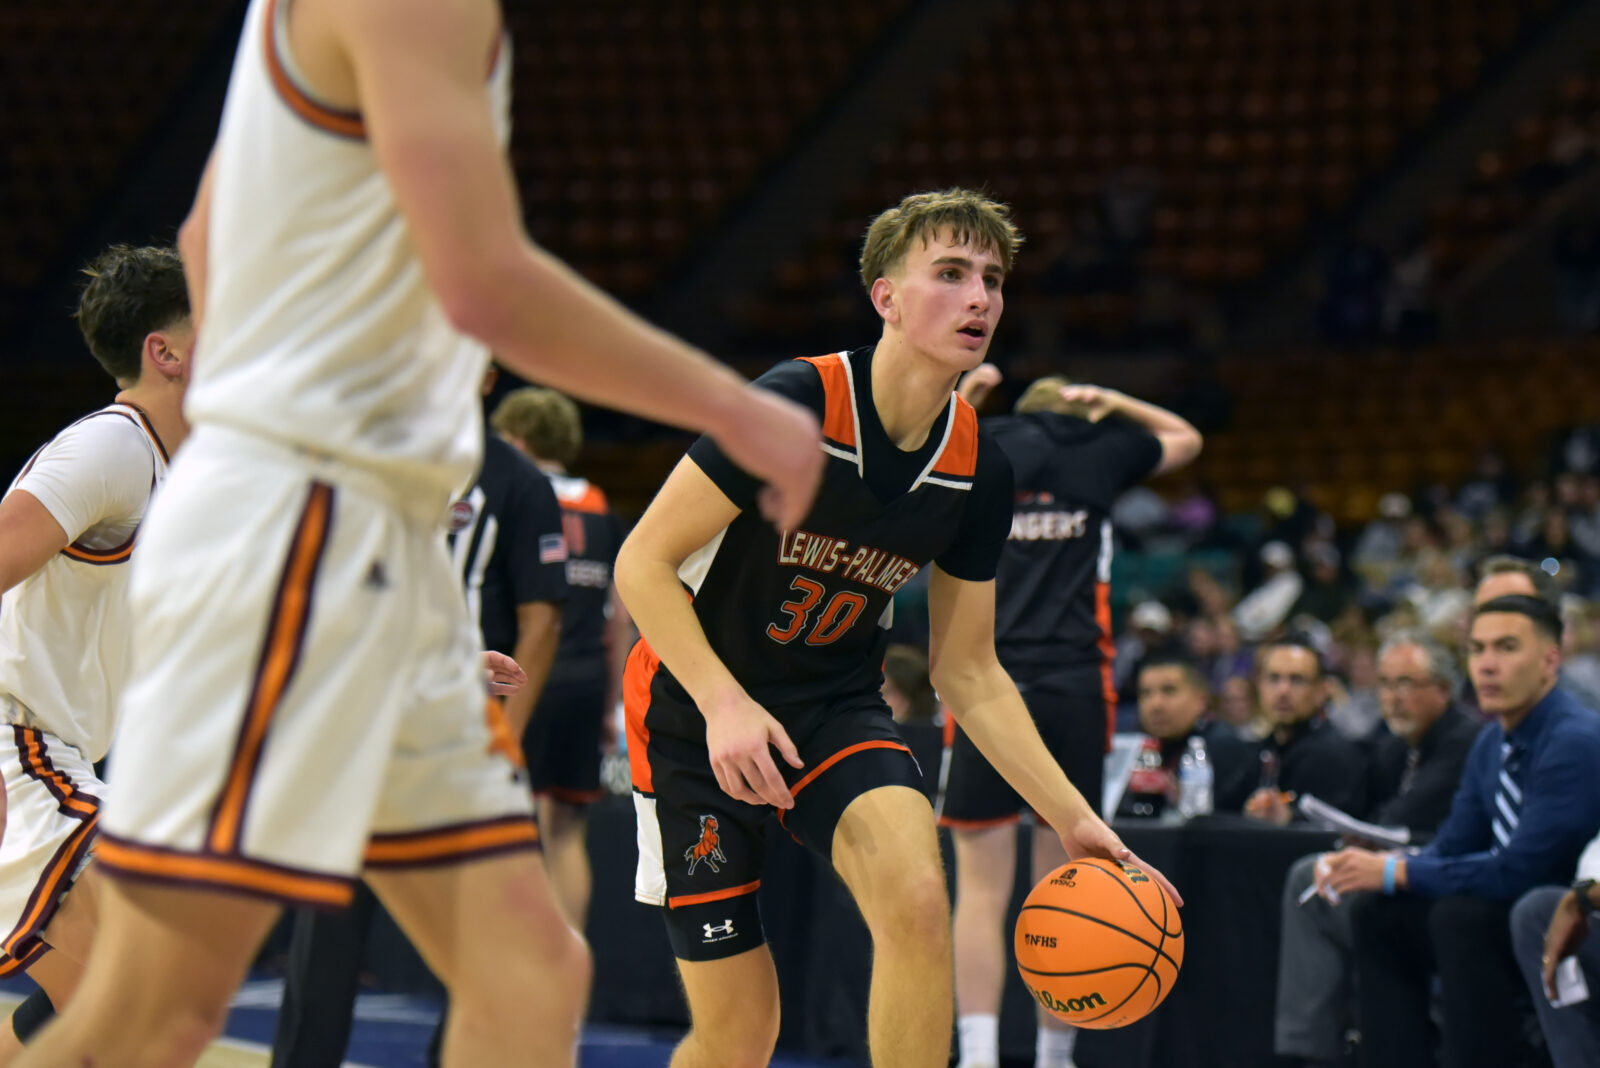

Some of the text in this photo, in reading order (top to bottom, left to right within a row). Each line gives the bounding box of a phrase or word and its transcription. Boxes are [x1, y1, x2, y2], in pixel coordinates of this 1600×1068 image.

[766, 575, 868, 645] 30
[1030, 935, 1057, 948] NFHS
[1025, 985, 1107, 1013] ilson
